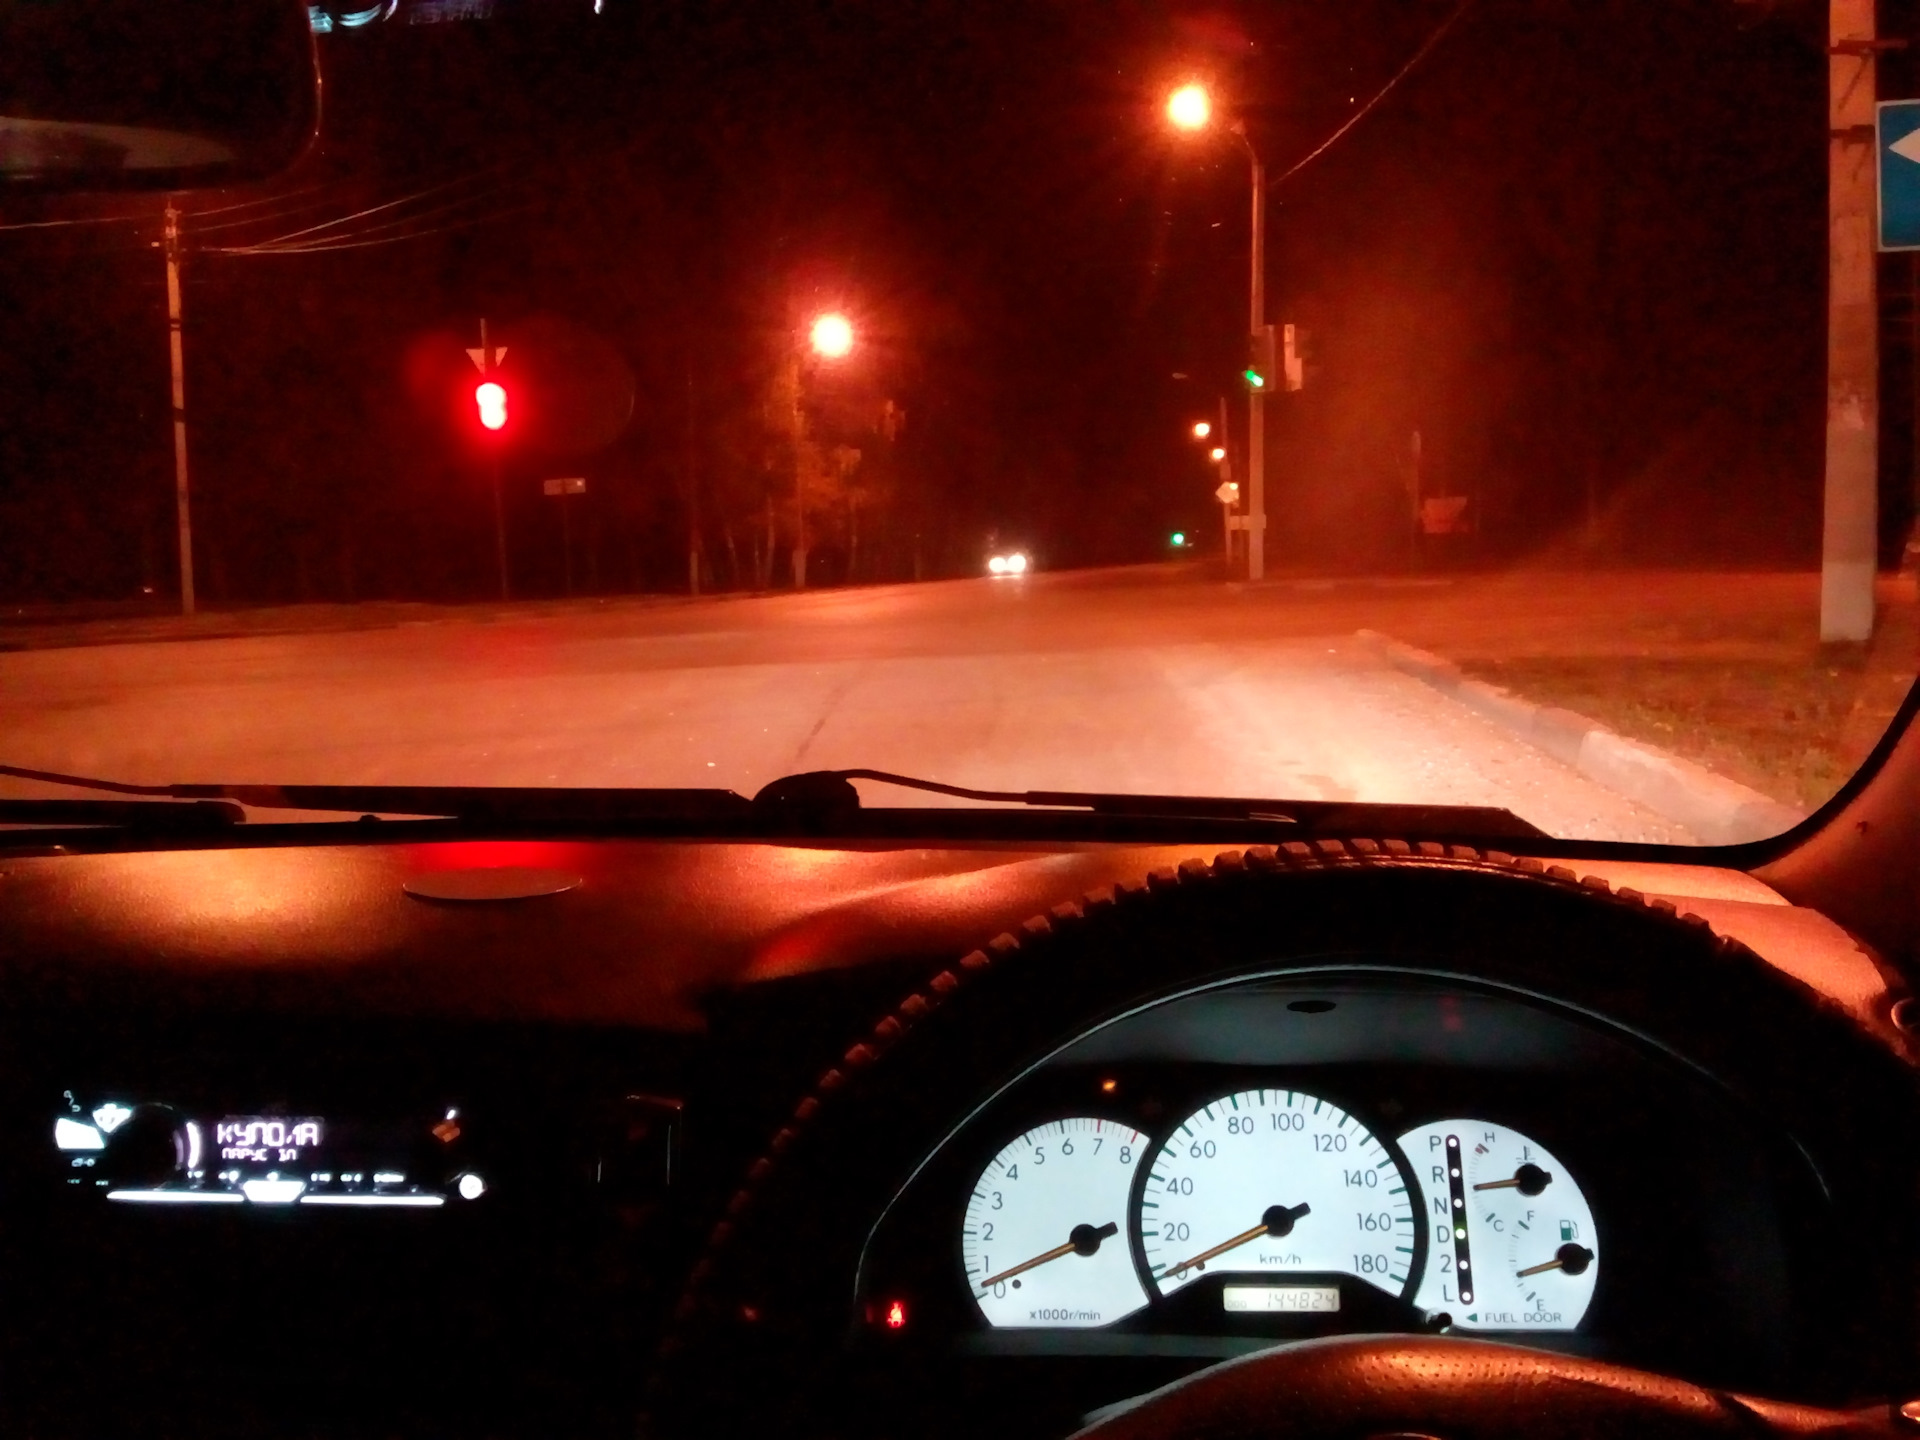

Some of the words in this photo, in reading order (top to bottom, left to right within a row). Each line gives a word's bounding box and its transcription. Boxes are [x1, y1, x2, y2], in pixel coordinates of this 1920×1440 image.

[1227, 1116, 1254, 1134] 80
[1271, 1113, 1305, 1131] 100
[1313, 1133, 1347, 1152] 120
[1429, 1135, 1442, 1151] P
[1484, 1132, 1495, 1142] H
[1061, 1138, 1074, 1155] 6
[1093, 1138, 1104, 1156] 7
[1119, 1146, 1132, 1164] 8
[1189, 1140, 1217, 1158] 60
[1034, 1147, 1045, 1165] 5
[1006, 1164, 1019, 1181] 4
[1343, 1169, 1378, 1188] 140
[1432, 1166, 1445, 1183] R
[1166, 1177, 1194, 1195] 40
[991, 1192, 1003, 1210] 3
[1434, 1197, 1448, 1214] N
[1357, 1213, 1392, 1231] 160
[1527, 1210, 1535, 1221] F
[982, 1223, 994, 1241] 2
[1164, 1223, 1190, 1241] 20
[1437, 1226, 1450, 1243] D
[1493, 1220, 1505, 1232] C
[1259, 1253, 1302, 1265] km/h
[1353, 1254, 1388, 1273] 180
[1440, 1255, 1452, 1273] 2
[993, 1281, 1006, 1299] 0
[1443, 1285, 1454, 1302] L
[1267, 1291, 1336, 1309] 144824
[1536, 1300, 1546, 1312] E
[1485, 1313, 1517, 1324] FUEL
[1524, 1313, 1562, 1323] DOOR
